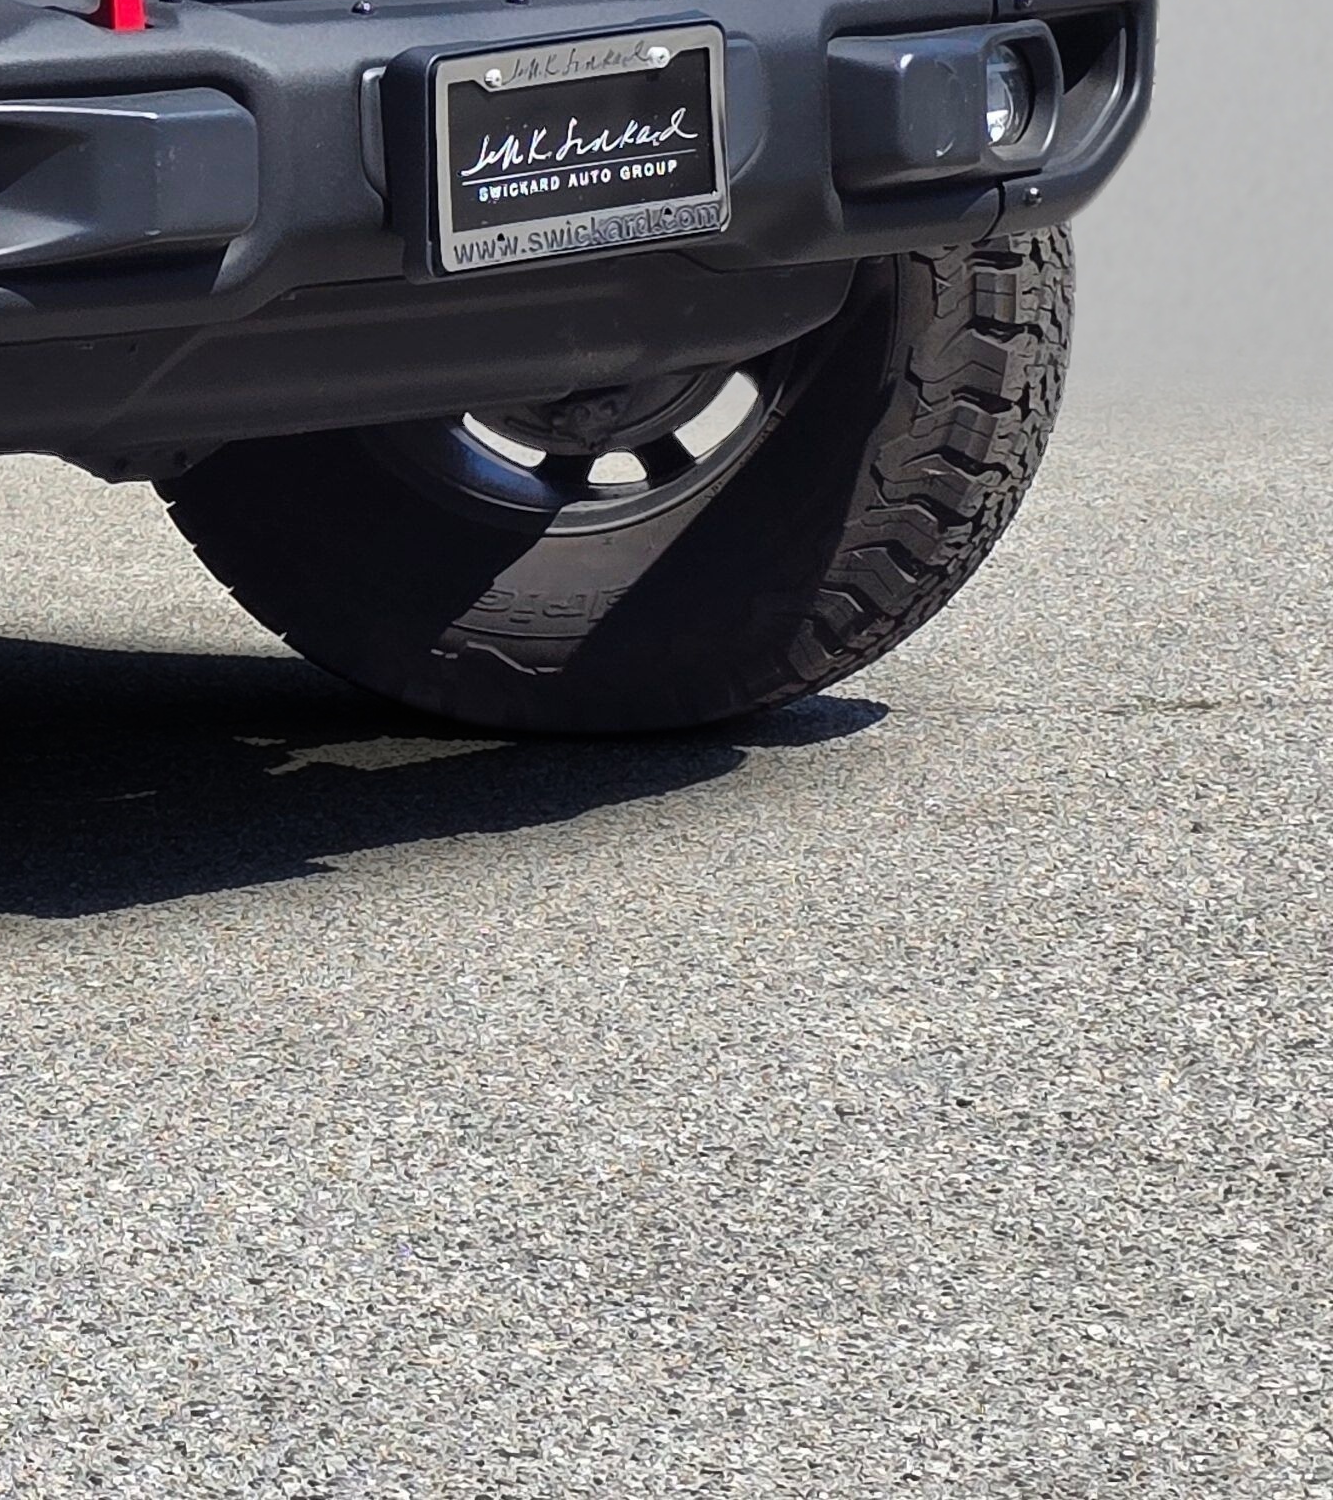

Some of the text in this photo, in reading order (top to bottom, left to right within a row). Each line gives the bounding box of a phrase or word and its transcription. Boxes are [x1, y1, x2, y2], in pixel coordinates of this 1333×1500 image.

[478, 159, 679, 203] SWICKARD AUTO GROUP
[453, 202, 721, 266] www.swickard.com
